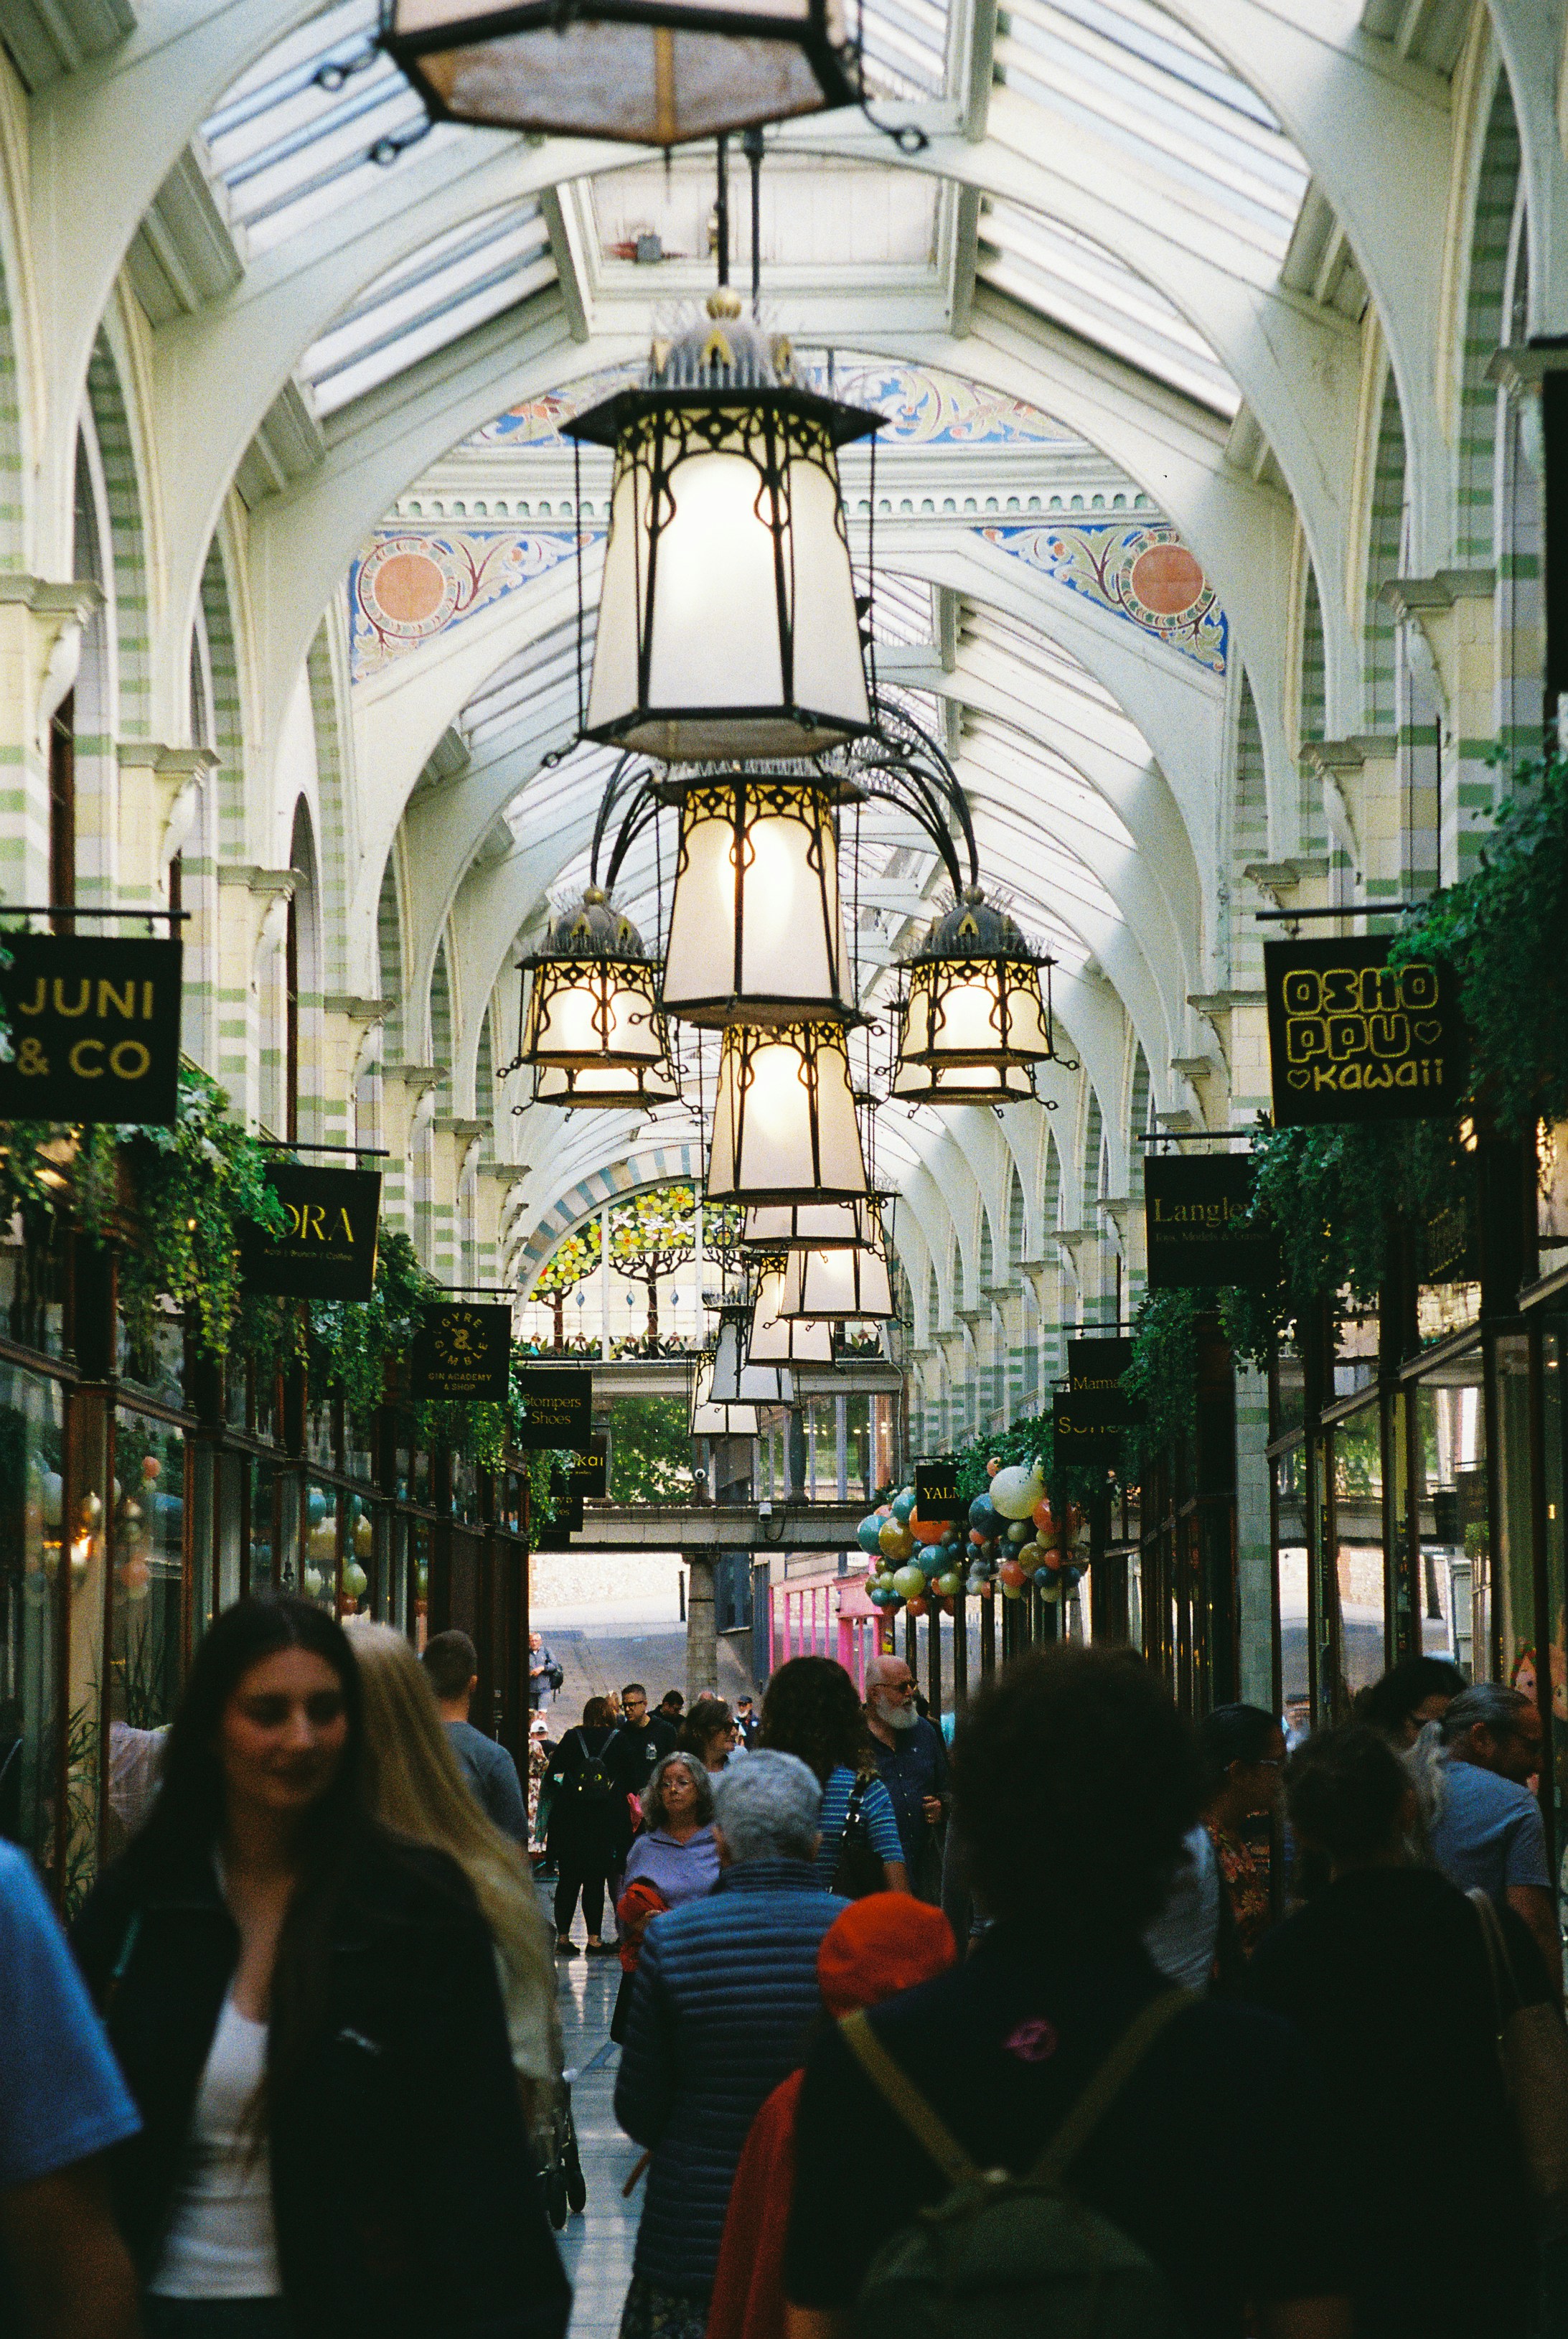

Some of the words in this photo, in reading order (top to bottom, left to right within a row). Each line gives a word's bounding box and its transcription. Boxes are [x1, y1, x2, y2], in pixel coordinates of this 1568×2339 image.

[19, 978, 153, 1020] JUNI
[1282, 964, 1439, 1016] OSHO
[18, 1038, 50, 1077] &
[69, 1039, 151, 1079] CO
[1285, 1013, 1410, 1064] PPU
[447, 1372, 492, 1382] ACADEMY
[522, 1393, 582, 1410] Stompers
[531, 1411, 572, 1425] Shoes
